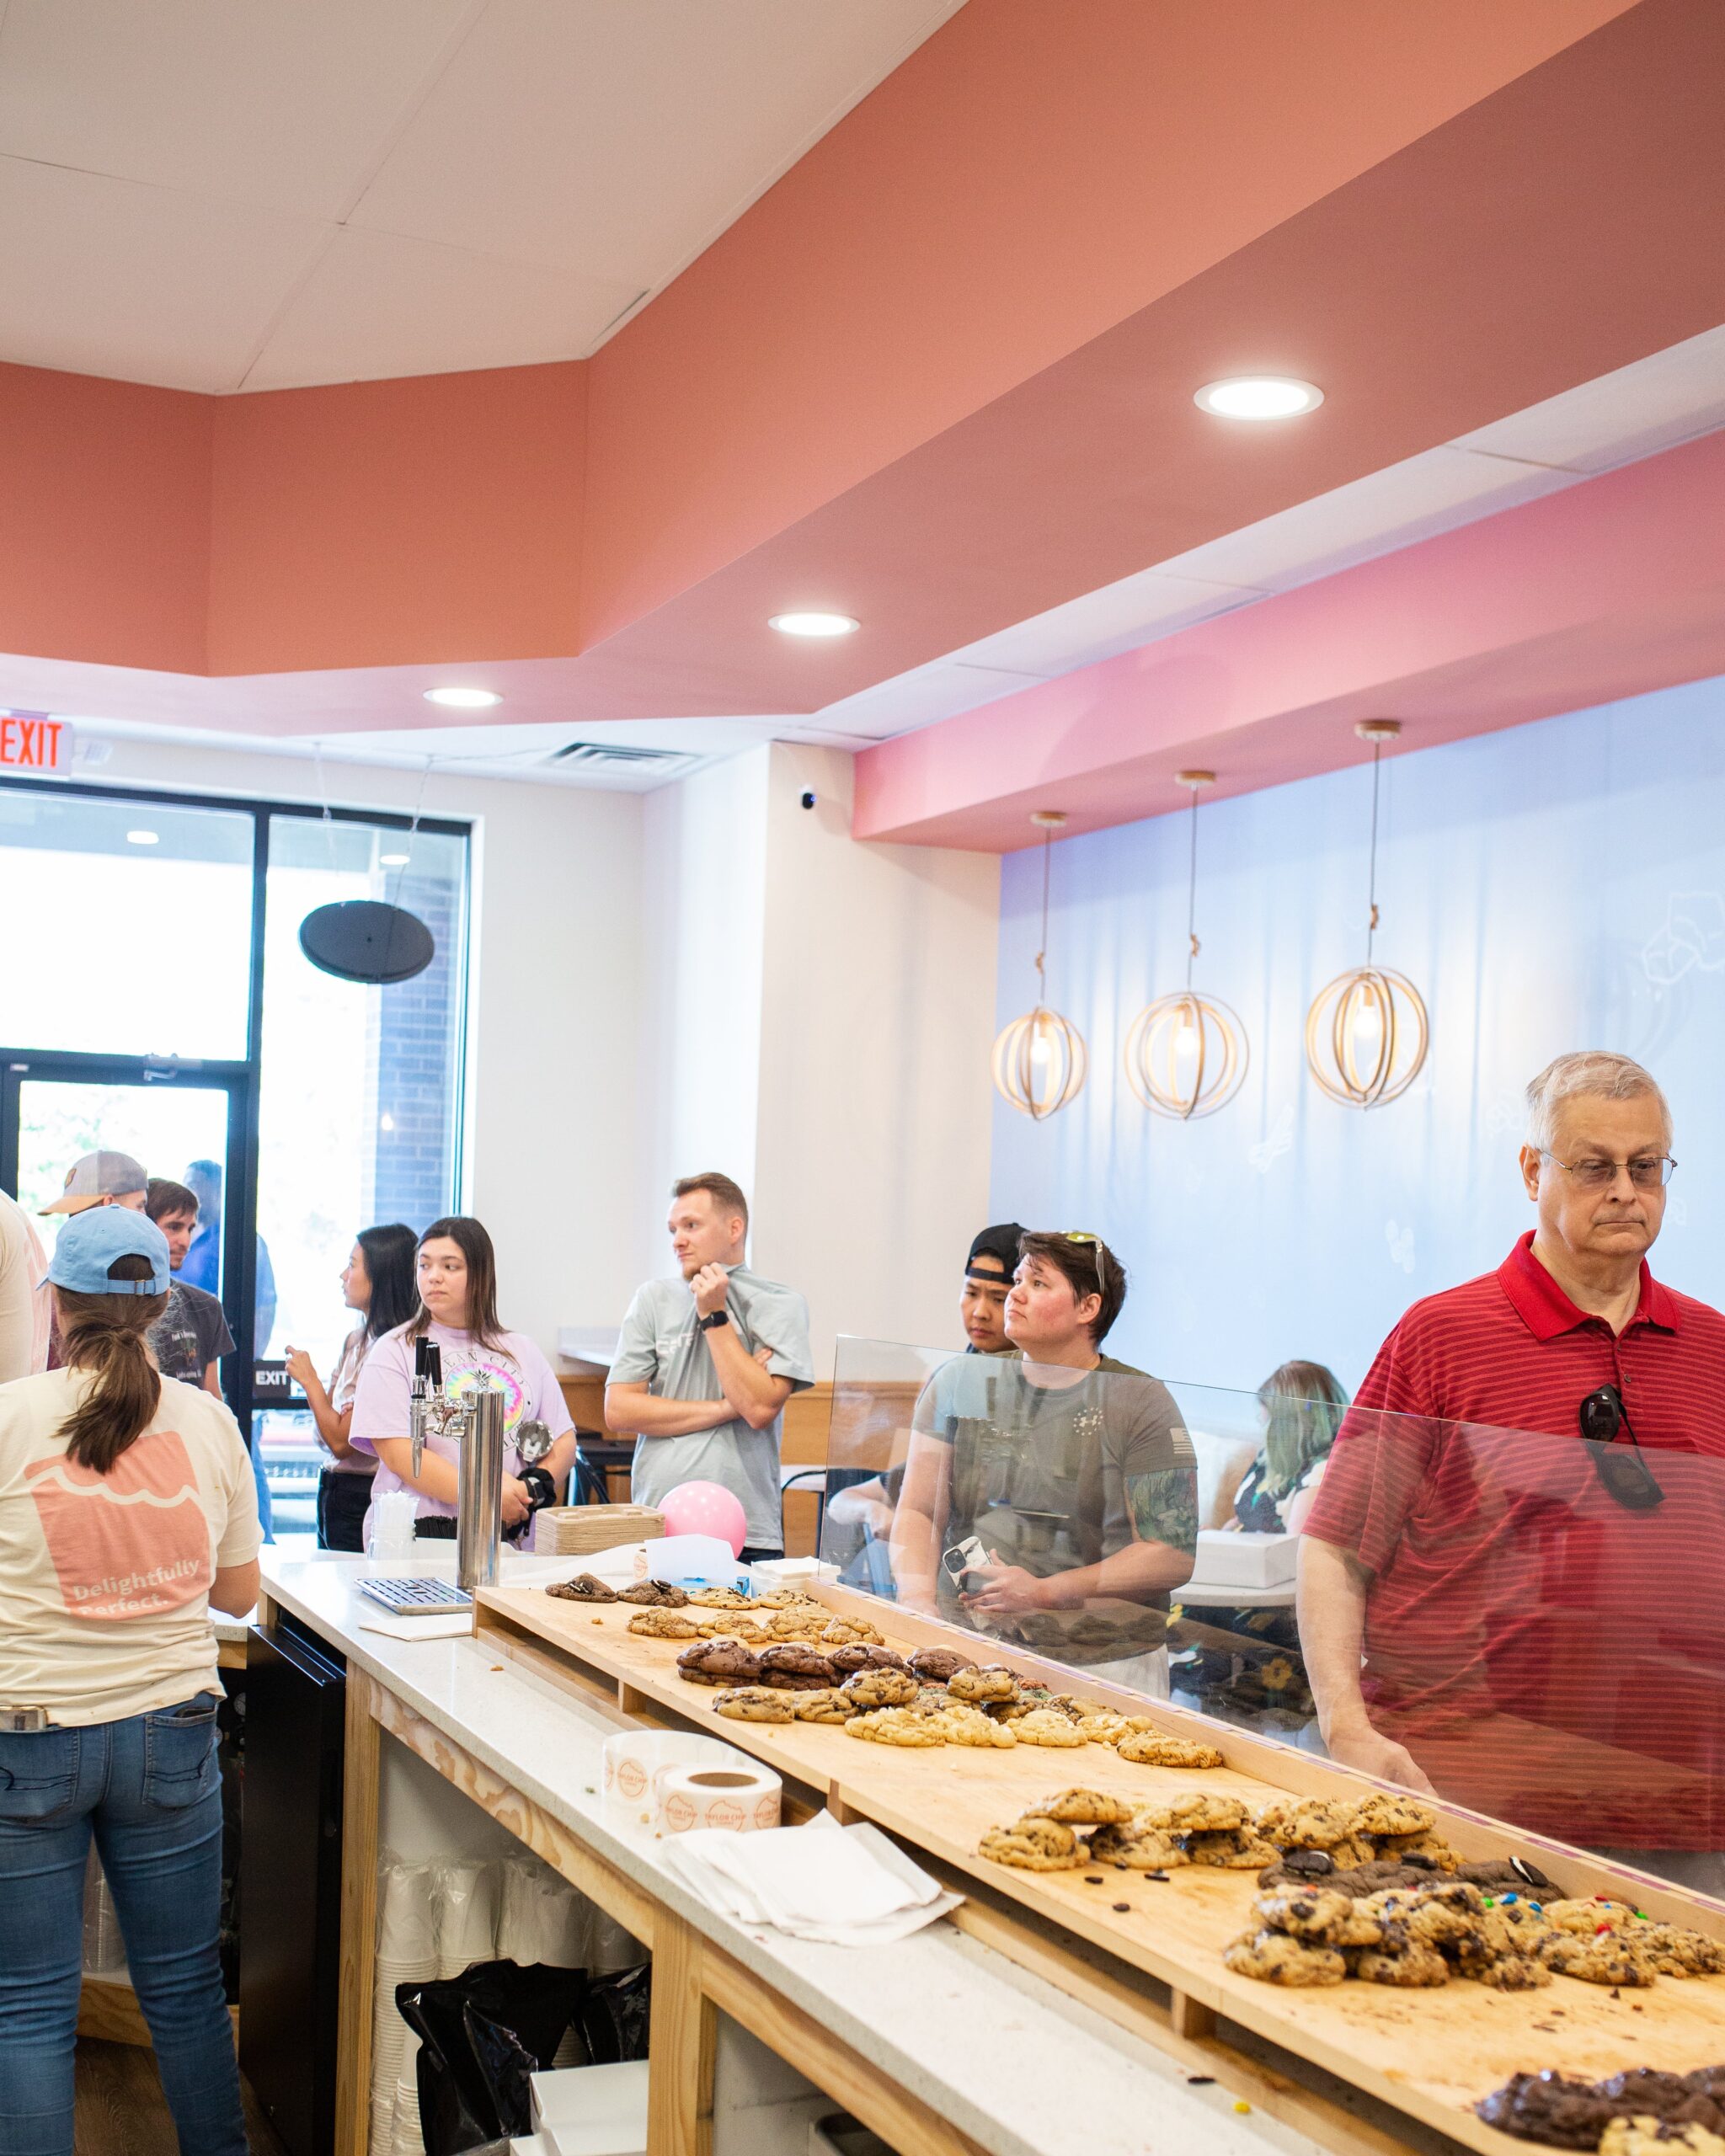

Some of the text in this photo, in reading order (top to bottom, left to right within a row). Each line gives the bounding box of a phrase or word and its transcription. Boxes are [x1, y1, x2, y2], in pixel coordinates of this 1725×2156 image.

[0, 718, 63, 768] EXIT
[442, 1352, 478, 1375] CEAN
[255, 1369, 289, 1386] EXIT
[72, 1559, 200, 1601] Delightfully
[77, 1593, 169, 1616] Perfect.
